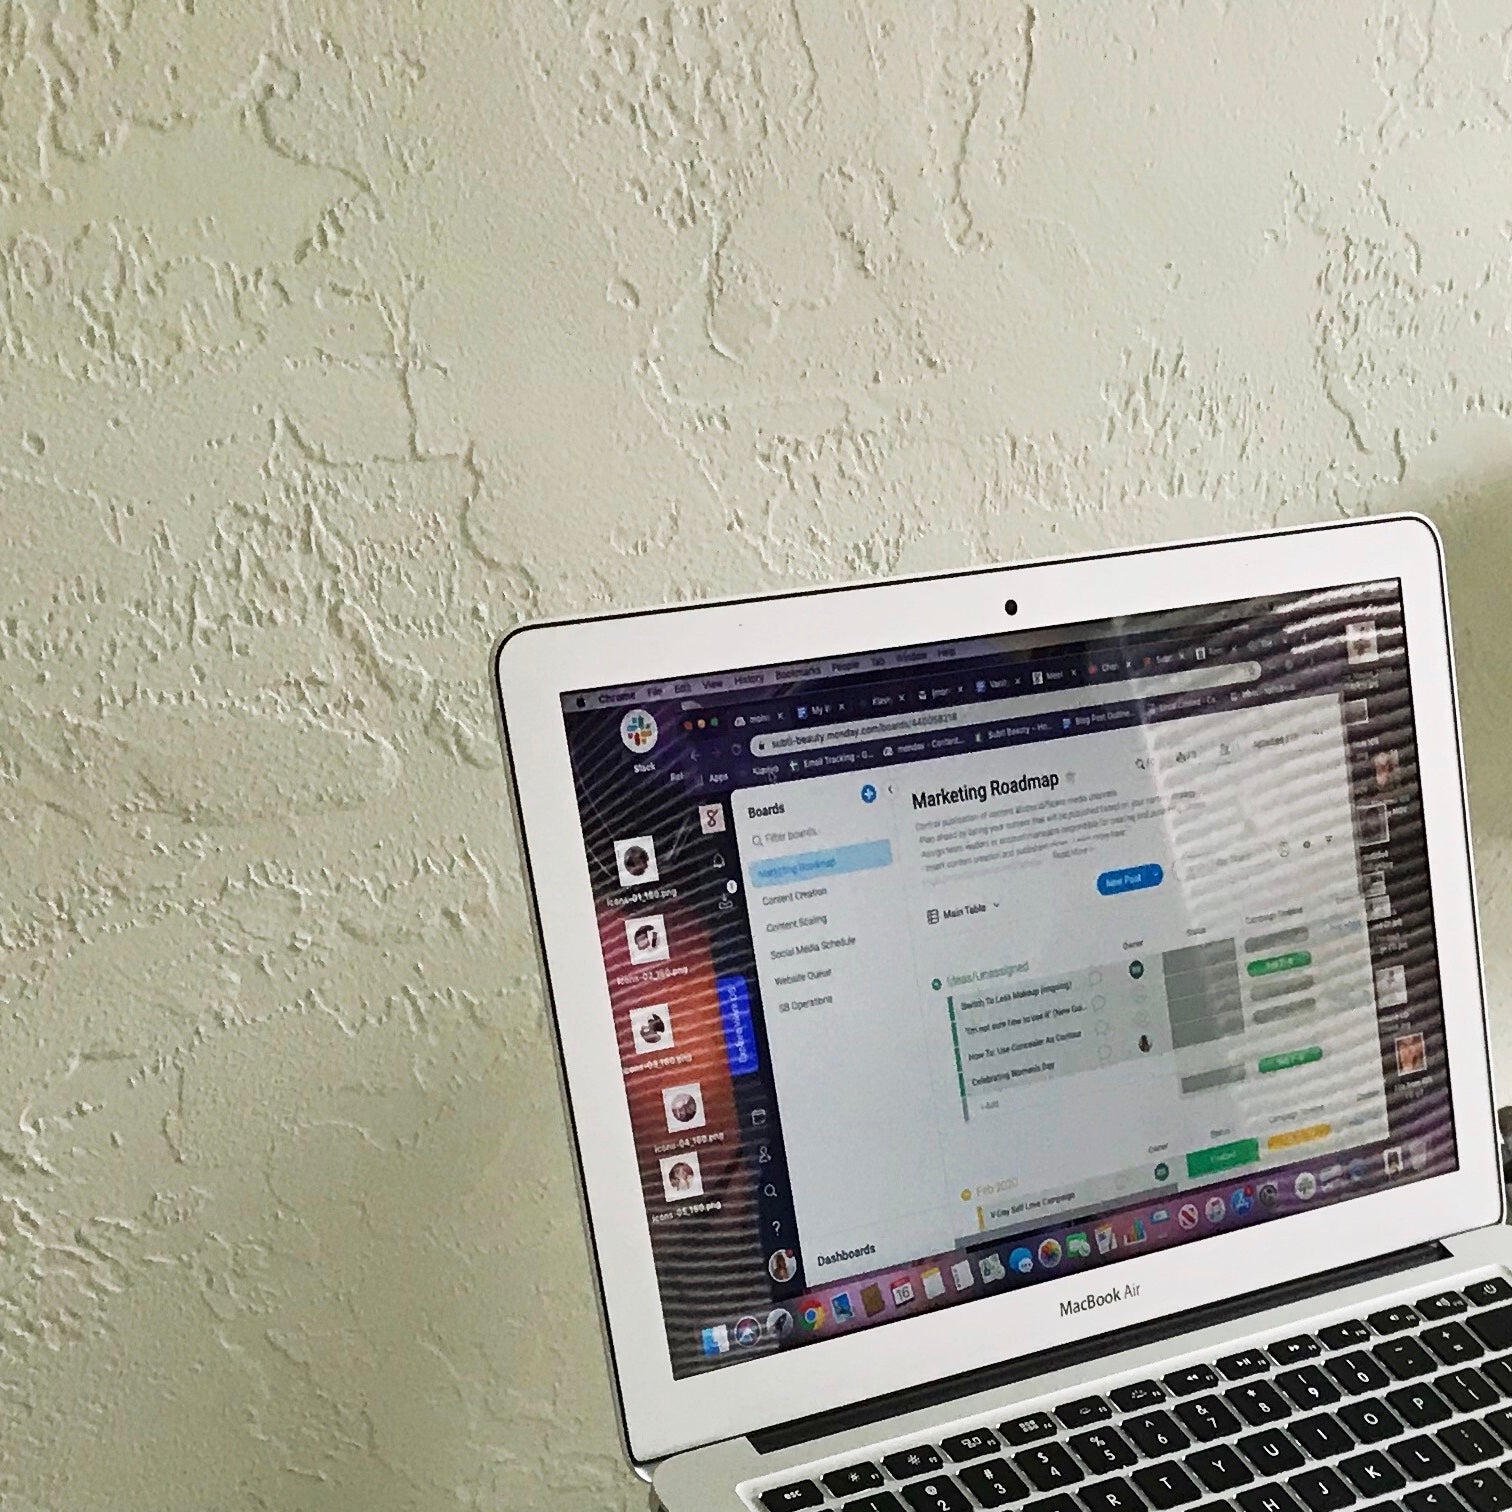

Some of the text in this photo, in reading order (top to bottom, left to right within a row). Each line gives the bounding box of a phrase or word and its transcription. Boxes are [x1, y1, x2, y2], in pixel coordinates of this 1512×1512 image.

[598, 690, 635, 703] Chrome
[647, 686, 663, 697] File
[674, 683, 691, 694] Edit
[702, 679, 723, 690] View
[734, 673, 764, 685] History
[633, 762, 656, 774] Slack
[912, 771, 1060, 810] Marketing Roadmap
[748, 802, 785, 818] Boards
[762, 890, 793, 906] Content
[943, 903, 986, 920] Main Table
[770, 936, 856, 960] Social Media Schedule
[968, 1051, 985, 1062] How
[976, 1183, 995, 1196] Feb
[817, 1243, 876, 1267] Dashboards
[895, 1285, 910, 1299] 16
[1059, 1282, 1141, 1317] MacBook Air
[1357, 1372, 1369, 1382] 0
[1308, 1388, 1318, 1397] 9
[1259, 1403, 1270, 1412] 8
[1413, 1398, 1423, 1409] P
[1207, 1418, 1217, 1428] 7
[1364, 1413, 1378, 1424] O
[1158, 1434, 1167, 1444] 6
[1317, 1429, 1327, 1440] I
[1104, 1450, 1115, 1460] 5
[1264, 1444, 1279, 1456] U
[1415, 1451, 1429, 1462] L
[1051, 1467, 1061, 1476] 4
[1212, 1460, 1225, 1472] Y
[1365, 1466, 1381, 1478] K
[994, 1484, 1006, 1494] 3
[1160, 1477, 1171, 1489] T
[1319, 1482, 1328, 1494] J
[783, 1489, 802, 1501] esc
[1106, 1494, 1121, 1506] R
[937, 1500, 950, 1511] 2
[1263, 1499, 1280, 1512] H
